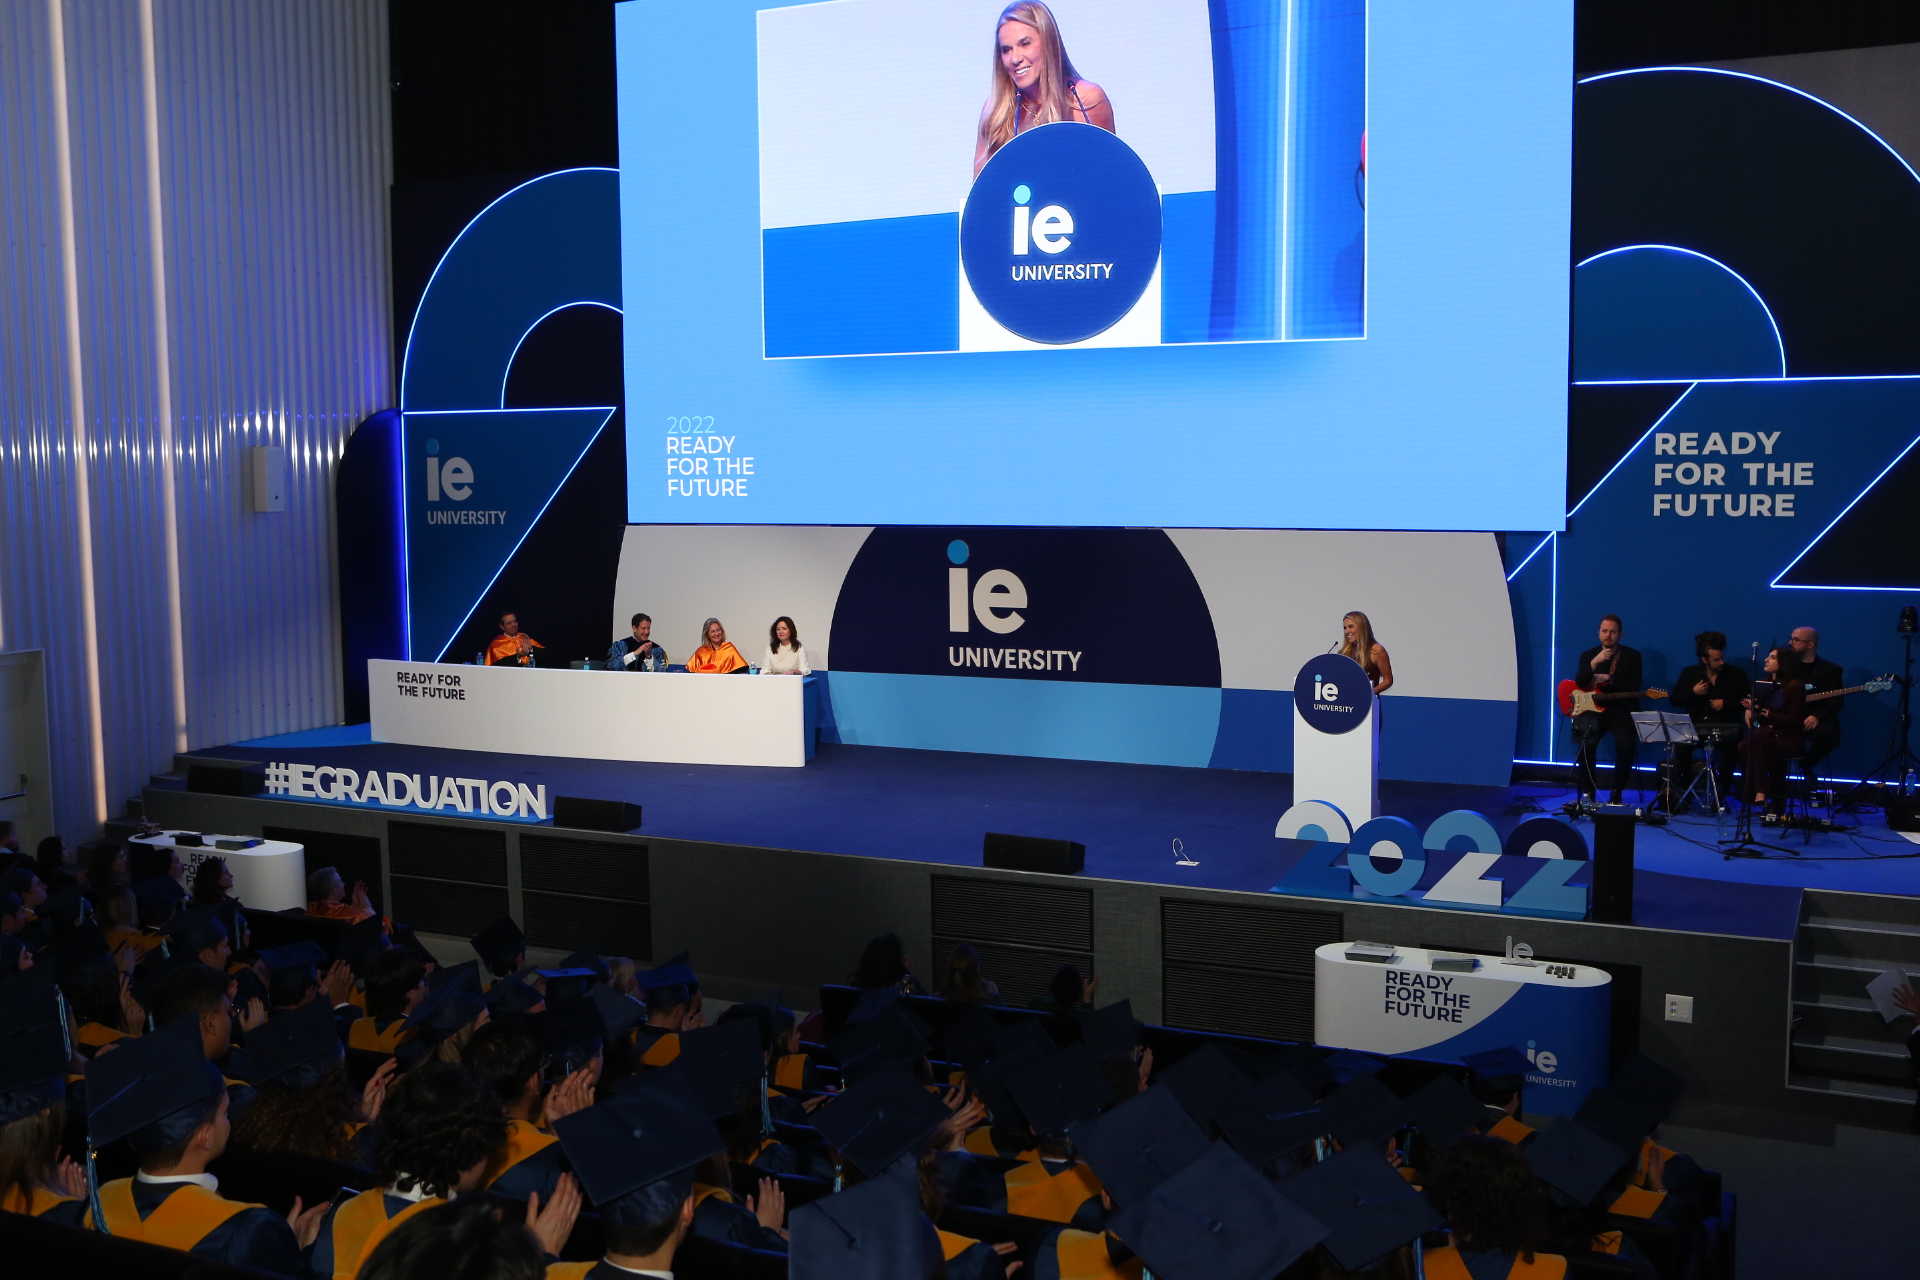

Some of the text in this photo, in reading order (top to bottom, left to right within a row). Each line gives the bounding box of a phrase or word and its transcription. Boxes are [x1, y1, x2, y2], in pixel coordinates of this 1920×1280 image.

[1013, 184, 1074, 256] ie
[1012, 263, 1114, 281] UNIVERSITY
[666, 415, 716, 434] 2022
[666, 435, 736, 454] READY
[1655, 431, 1782, 455] READY
[425, 438, 475, 502] ie
[667, 456, 755, 476] FOR THE
[1654, 462, 1814, 486] FOR THE
[667, 478, 748, 497] FUTURE
[1653, 493, 1795, 517] FUTURE
[427, 510, 507, 526] UNIVERSITY
[947, 539, 1028, 635] ie
[949, 646, 1082, 672] UNIVERSITY
[397, 671, 462, 687] READY FOR
[1314, 674, 1339, 702] ie
[398, 684, 466, 701] THE FUTURE
[1313, 703, 1354, 713] UNIVERSITY
[264, 761, 547, 819] #IEGRADUATION
[1268, 799, 1589, 914] 2022
[1385, 969, 1454, 992] READY
[1385, 985, 1471, 1010] FOR THE
[1384, 1000, 1463, 1024] FUTURE
[1526, 1039, 1558, 1074] ie
[1525, 1074, 1577, 1088] UNIVERSITY
